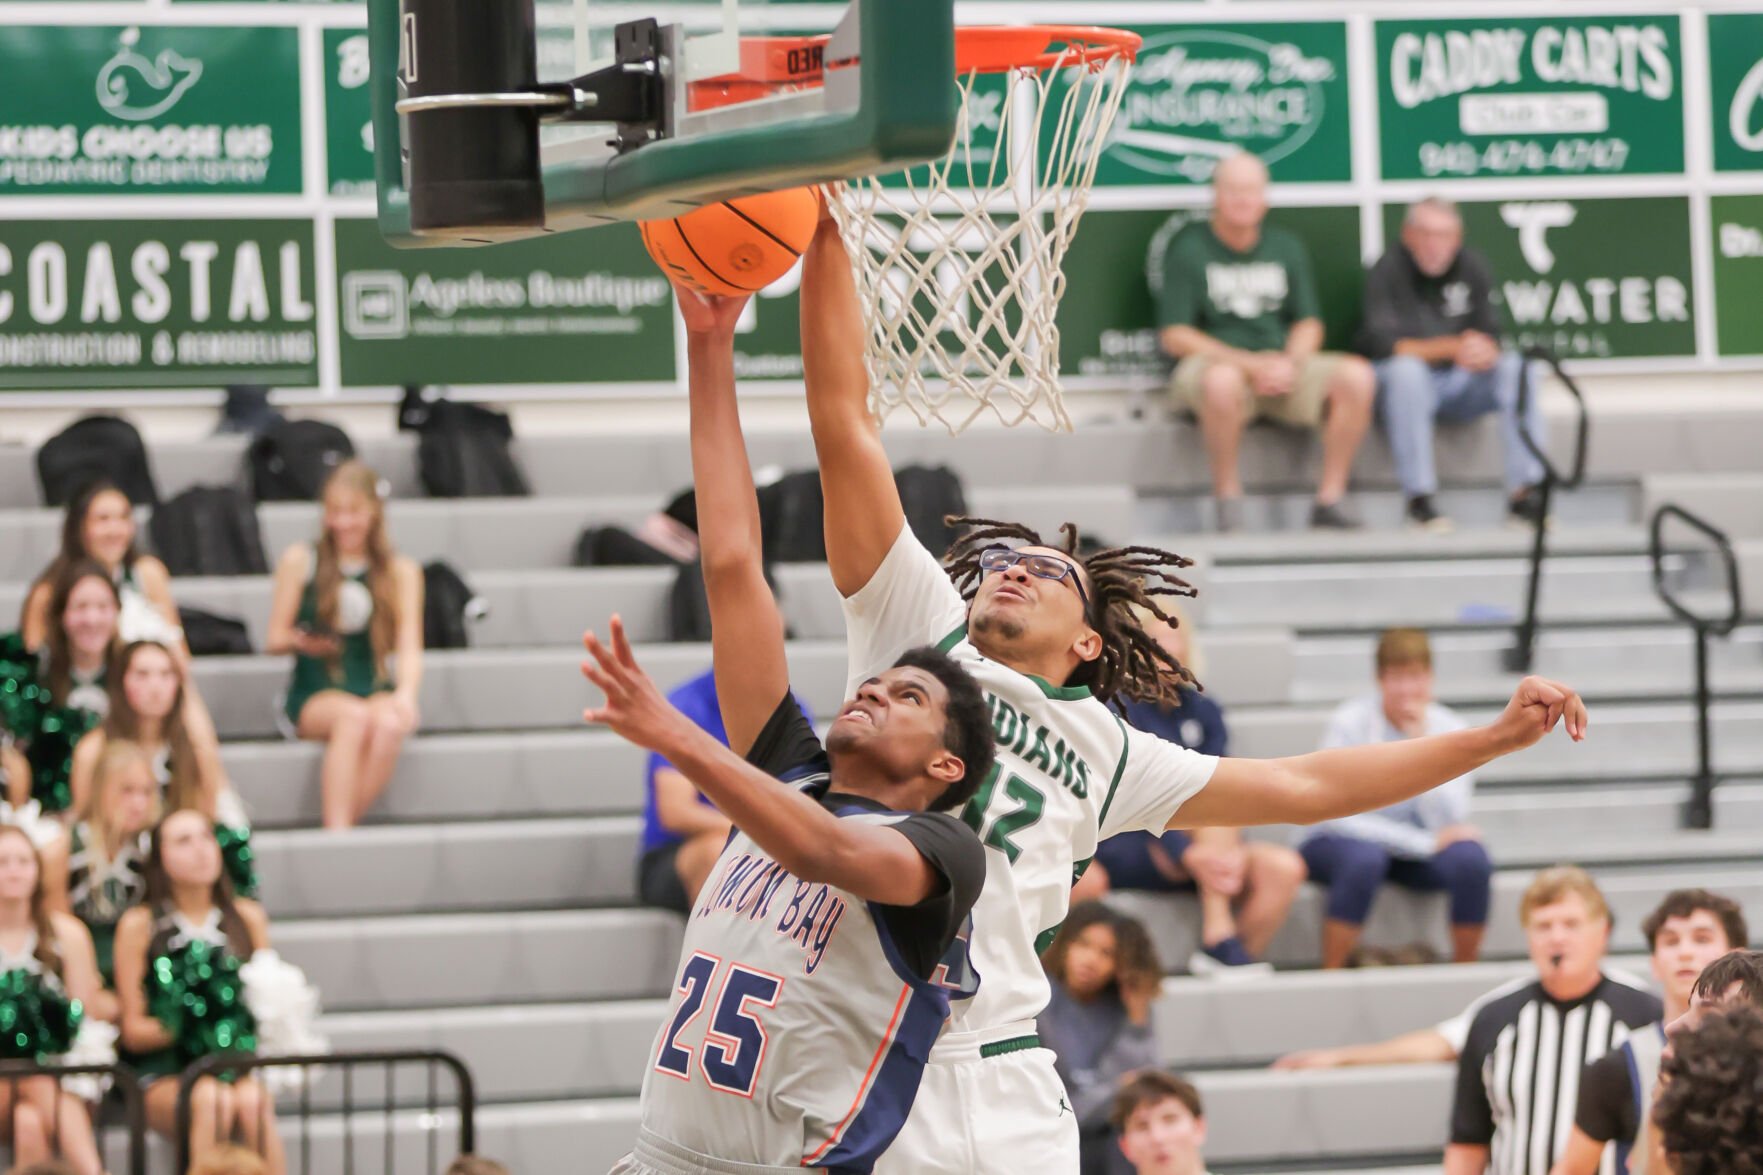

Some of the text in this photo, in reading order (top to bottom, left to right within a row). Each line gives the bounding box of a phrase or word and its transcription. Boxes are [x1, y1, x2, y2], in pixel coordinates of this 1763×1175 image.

[1390, 25, 1673, 108] CADDY CARTS
[1112, 86, 1312, 127] NSURANCE
[81, 123, 222, 161] CHOOSE
[223, 123, 273, 160] US
[1502, 275, 1689, 326] WATER
[0, 332, 142, 367] ONSTRUCTION
[775, 878, 848, 976] BAY
[655, 949, 784, 1098] 25
